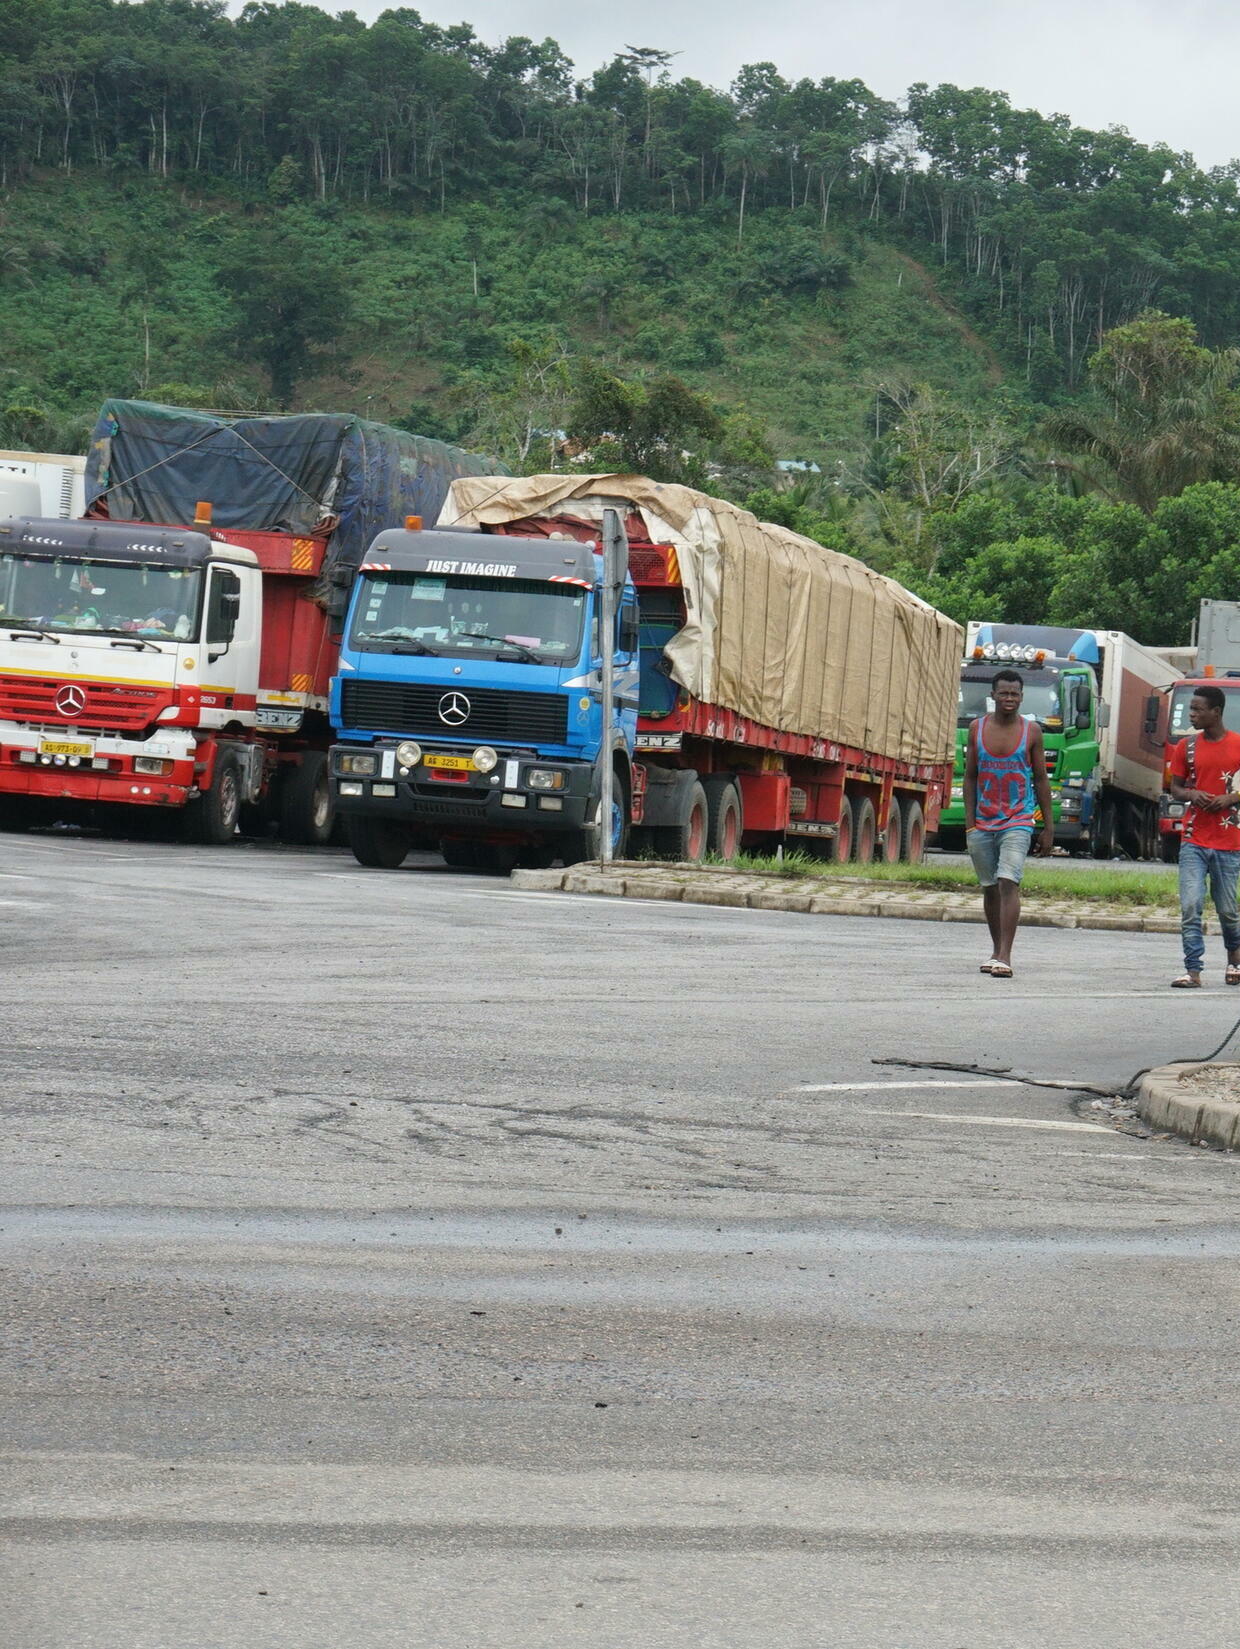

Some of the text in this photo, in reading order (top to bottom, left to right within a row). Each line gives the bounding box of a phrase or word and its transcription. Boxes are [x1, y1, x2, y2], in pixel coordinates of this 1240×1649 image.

[425, 559, 517, 577] JUST IMAGINE
[633, 735, 681, 746] ENZ
